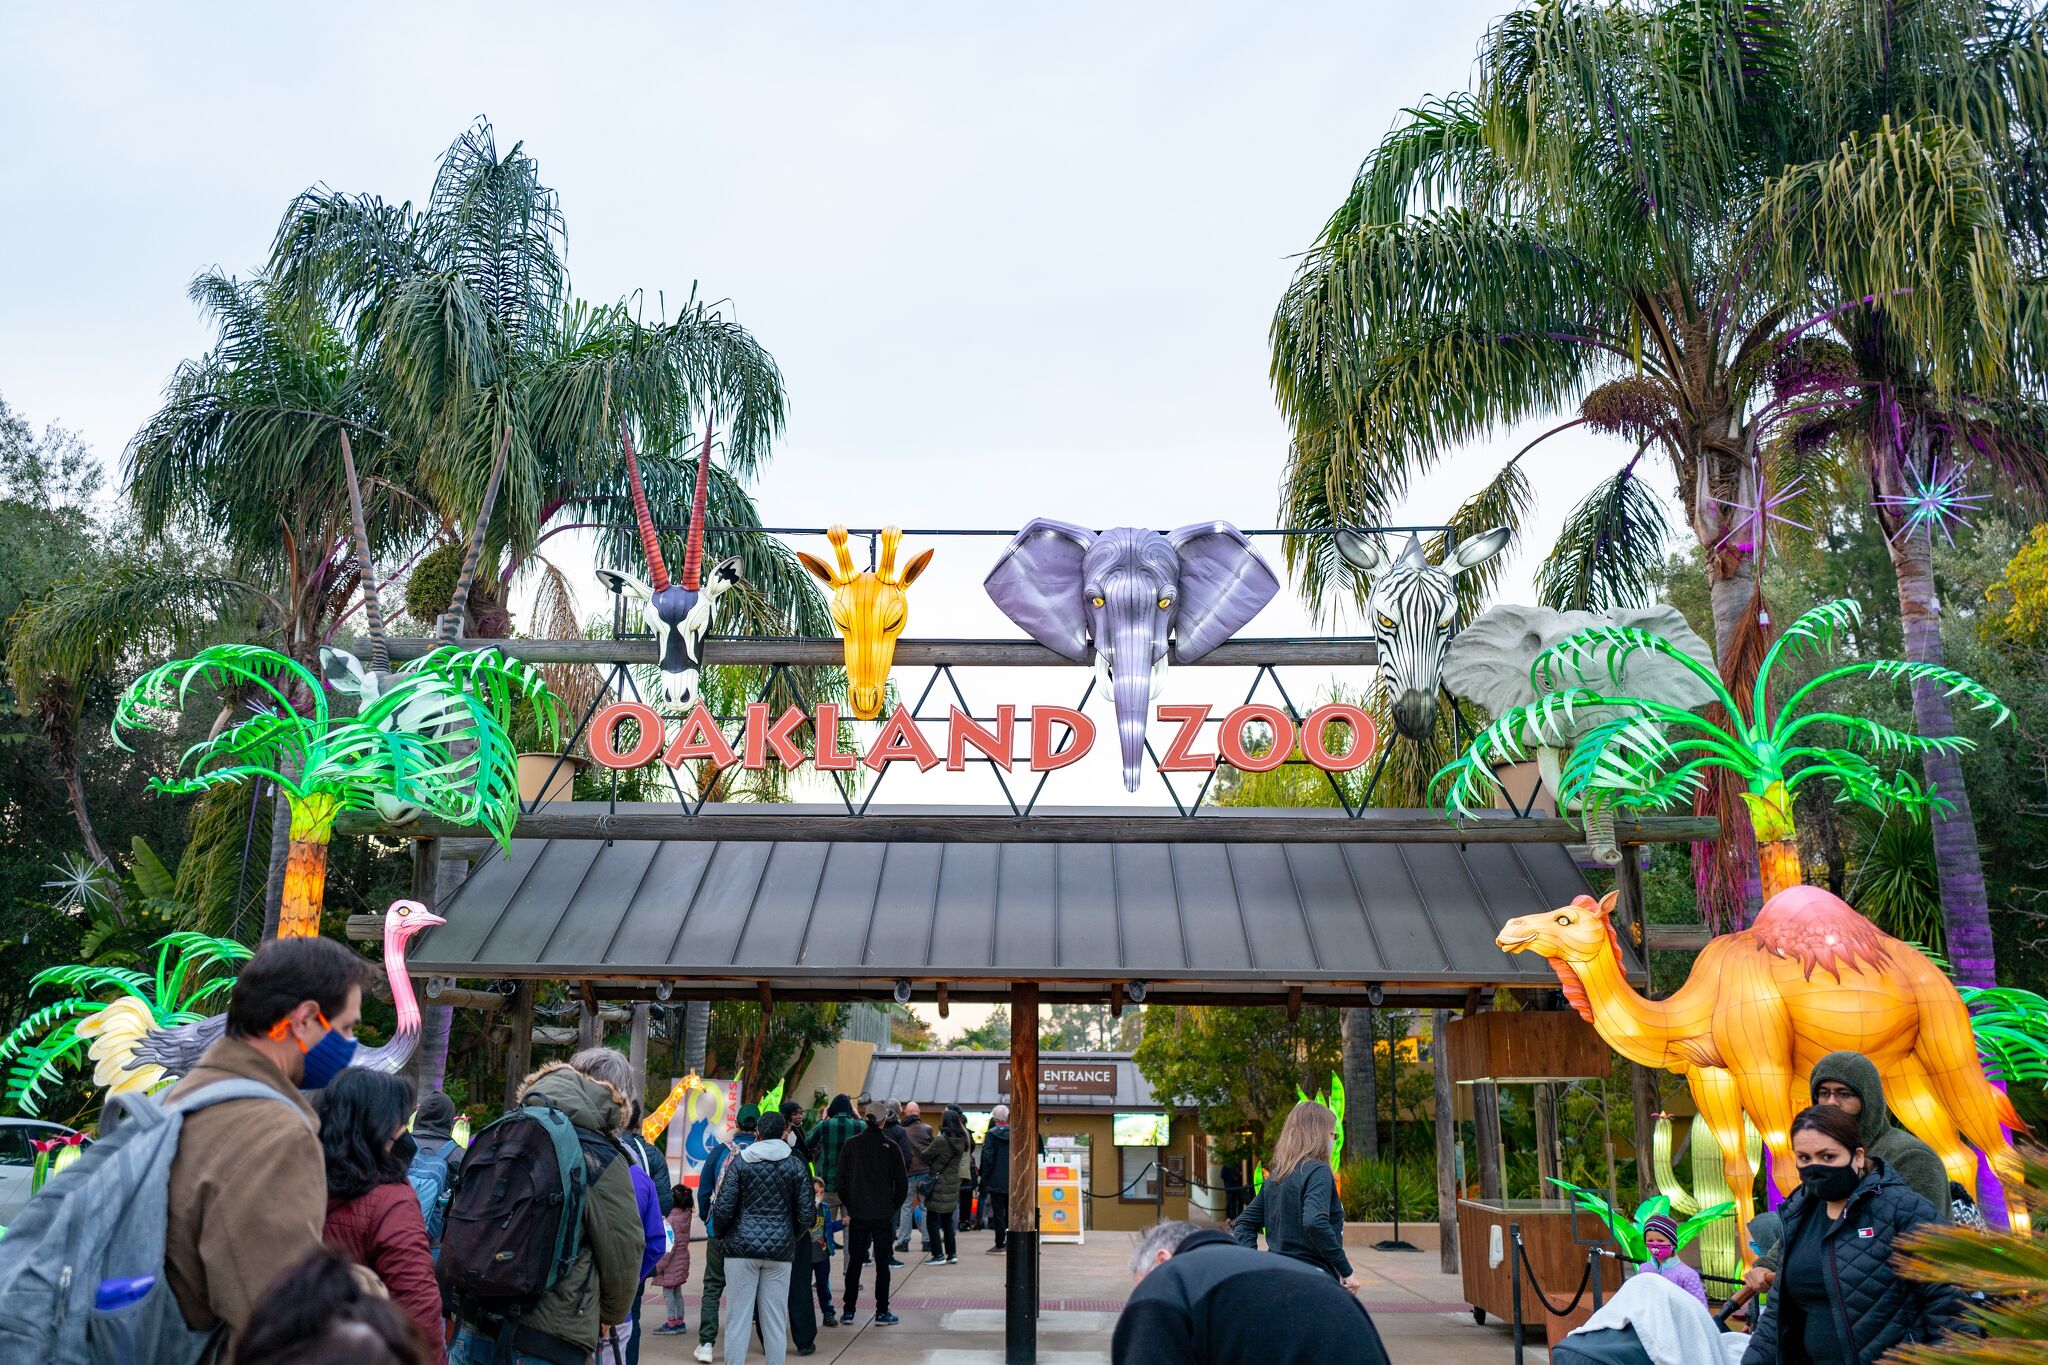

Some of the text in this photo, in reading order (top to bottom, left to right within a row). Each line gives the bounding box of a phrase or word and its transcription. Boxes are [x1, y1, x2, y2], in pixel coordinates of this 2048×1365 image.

[586, 700, 1379, 773] OAKLAND ZOO
[1043, 1070, 1111, 1082] ENTRANCE
[727, 1082, 738, 1132] YEARS
